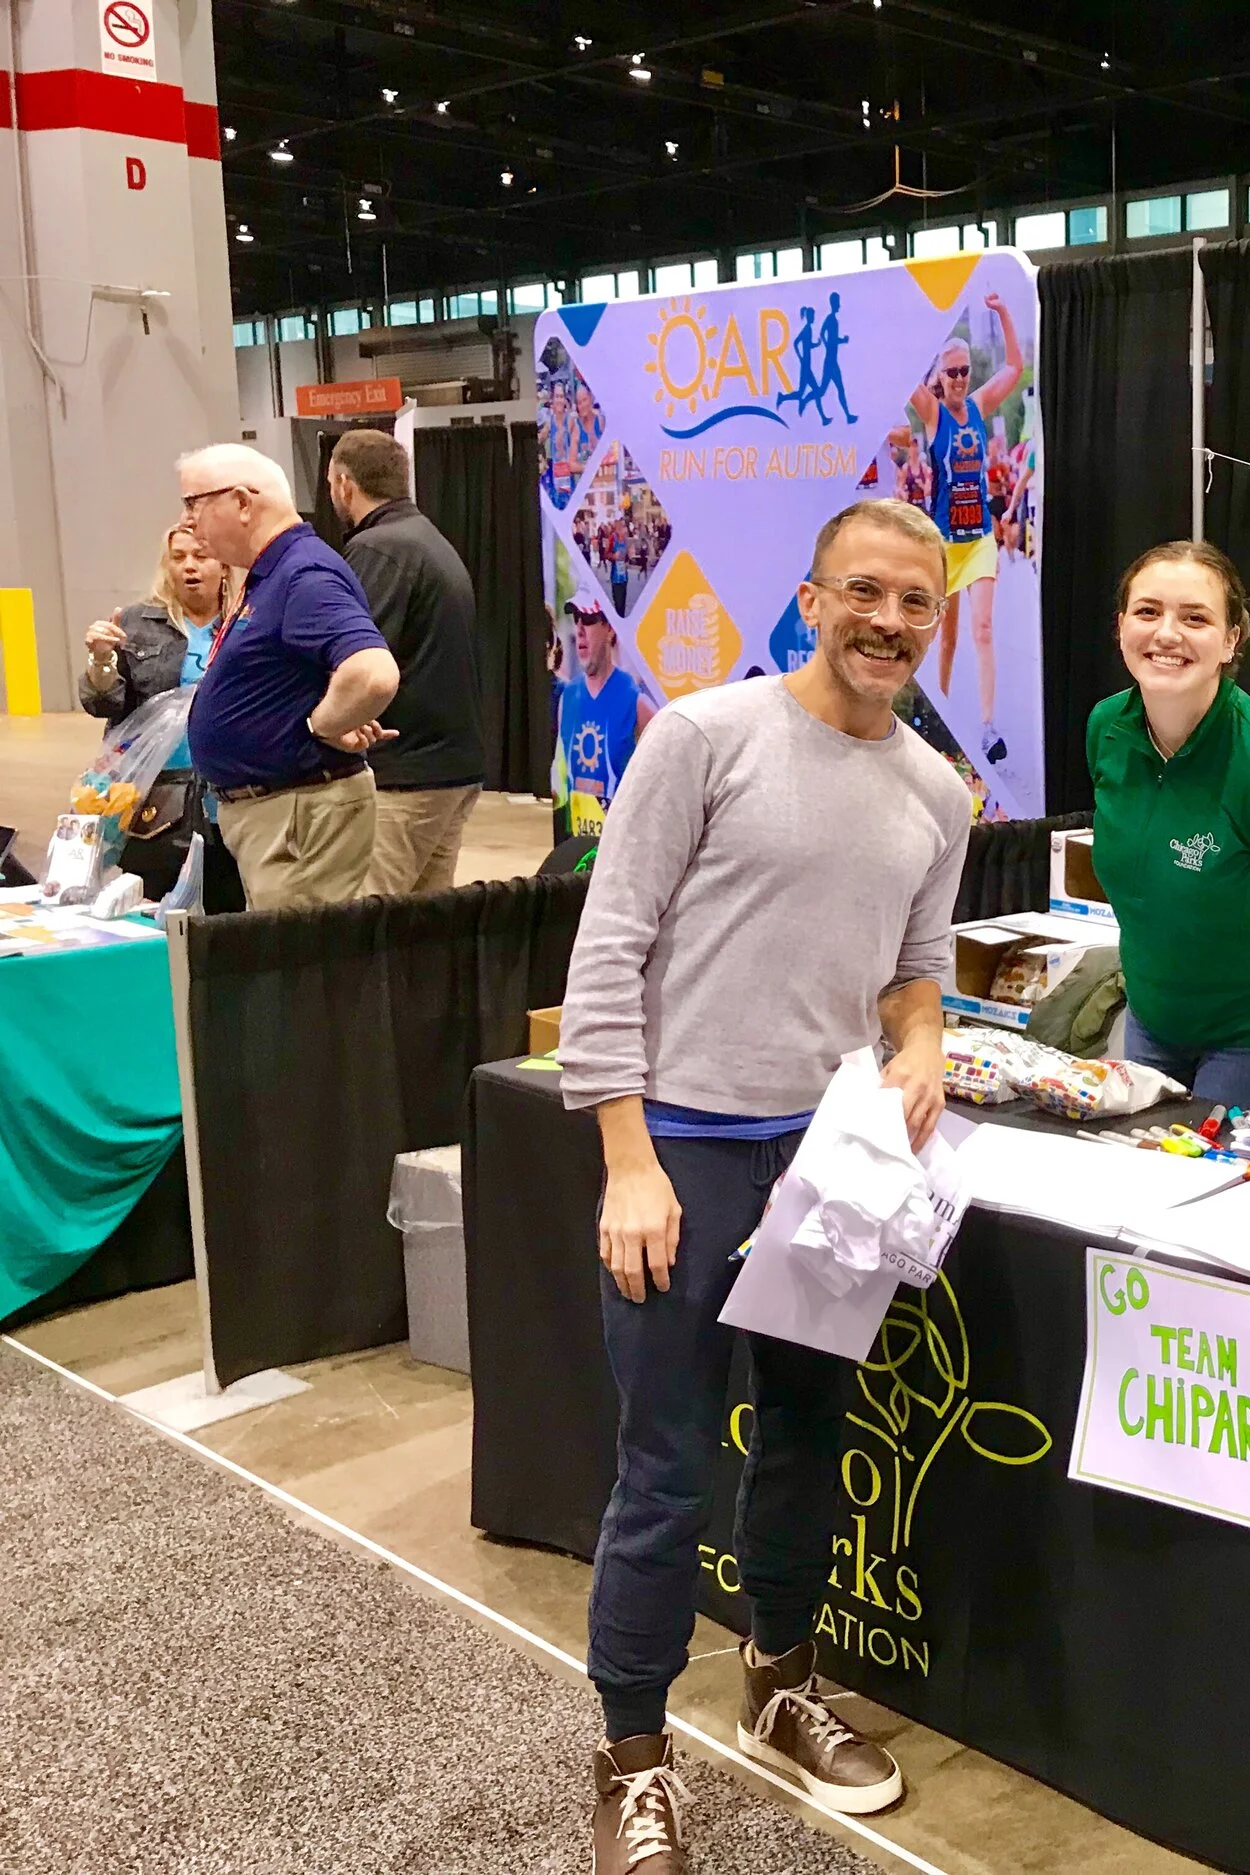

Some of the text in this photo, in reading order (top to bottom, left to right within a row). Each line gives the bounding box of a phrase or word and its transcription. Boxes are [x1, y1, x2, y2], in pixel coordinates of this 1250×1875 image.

[104, 51, 154, 67] NO SMOKING
[125, 156, 147, 191] D
[655, 307, 797, 402] OAR
[309, 383, 387, 409] Emergency Exit
[660, 443, 857, 481] RUN FOR AUTISM
[665, 607, 707, 638] RAISE
[662, 645, 713, 676] MONEY
[908, 1265, 932, 1283] PAR
[1100, 1264, 1150, 1315] GO
[1150, 1324, 1237, 1387] TEAM
